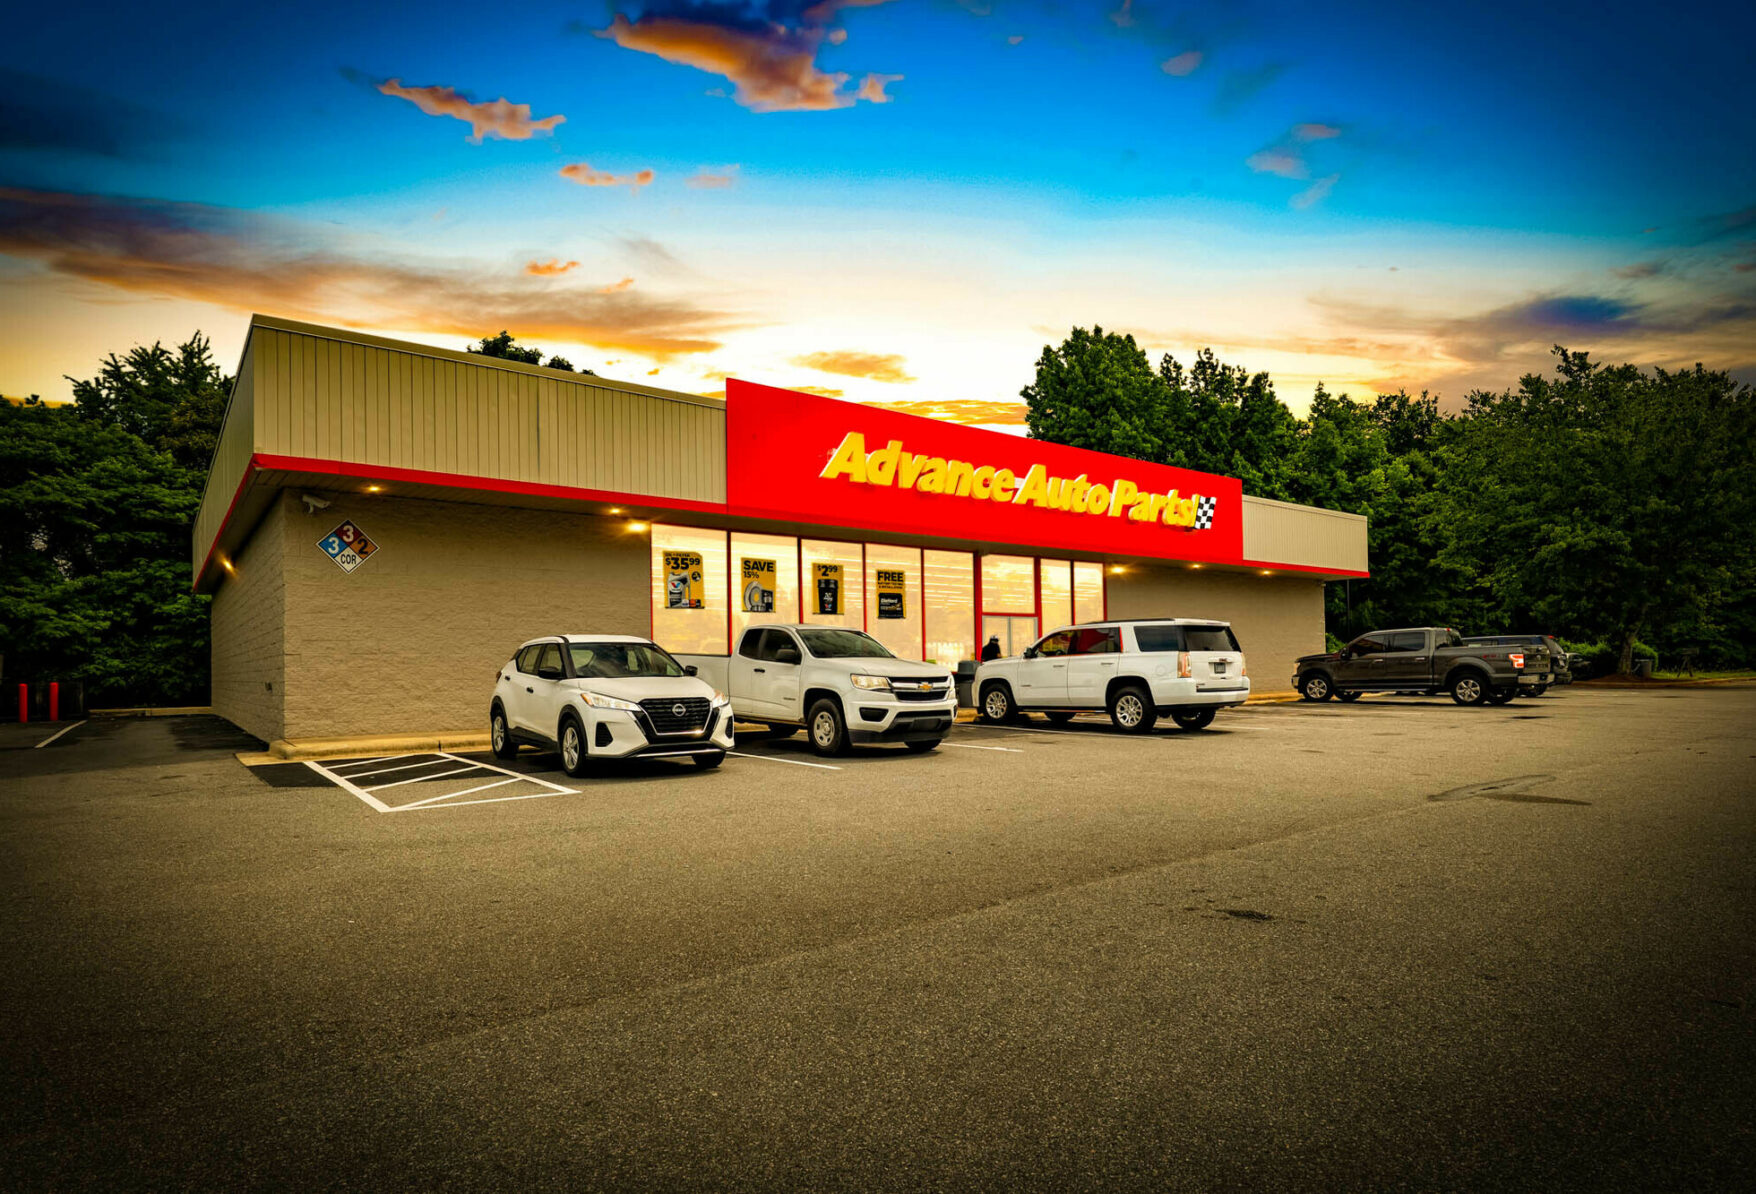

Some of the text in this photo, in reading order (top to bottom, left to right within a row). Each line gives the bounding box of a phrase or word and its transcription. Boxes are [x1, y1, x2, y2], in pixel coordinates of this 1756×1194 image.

[819, 431, 1196, 528] Advance Auto Parts
[342, 525, 354, 542] 3
[328, 537, 369, 555] 3 2
[340, 553, 357, 565] COR
[743, 560, 775, 573] SAVE
[743, 571, 760, 579] 15%
[877, 571, 904, 582] FREE
